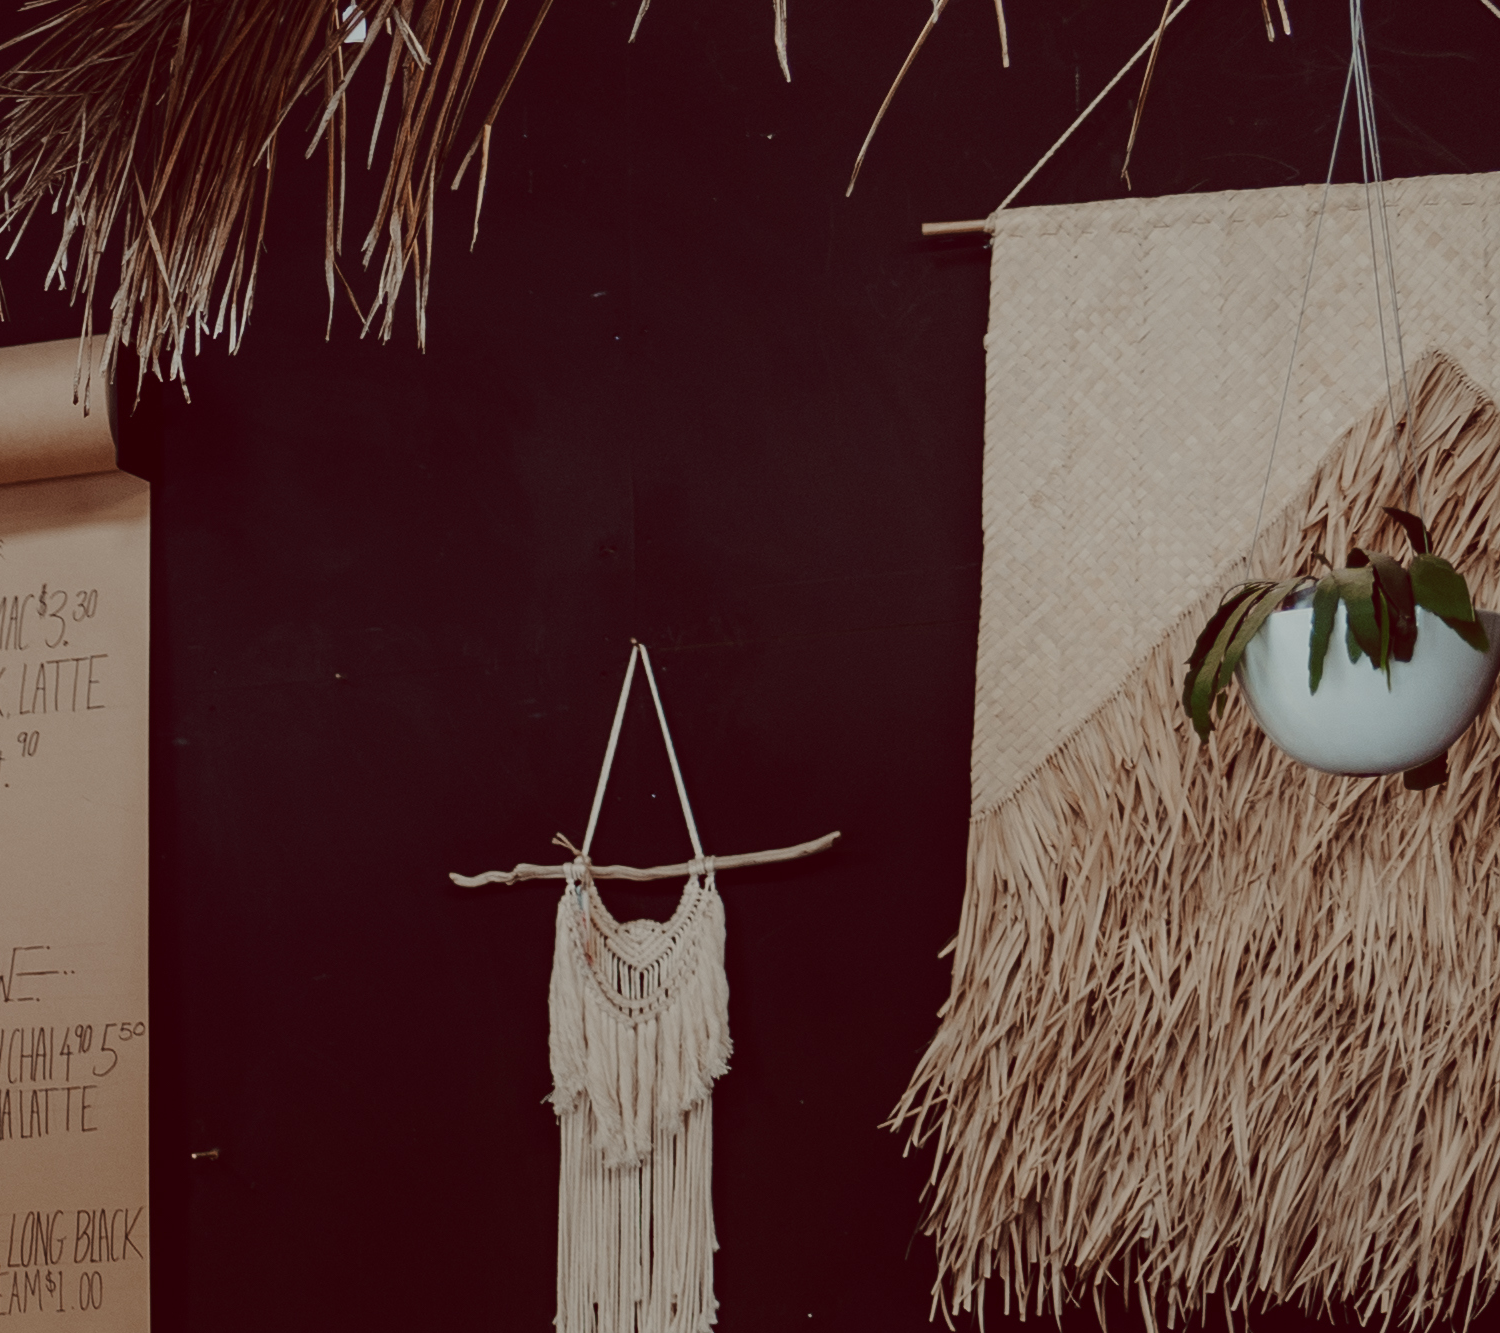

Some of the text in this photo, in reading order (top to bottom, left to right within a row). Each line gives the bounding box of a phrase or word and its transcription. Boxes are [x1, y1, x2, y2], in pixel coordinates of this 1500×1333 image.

[19, 654, 109, 715] LATTE
[8, 1027, 54, 1084] CHAI
[19, 1085, 98, 1139] LATTE
[7, 1210, 66, 1268] LONG
[73, 1205, 145, 1264] BLACK
